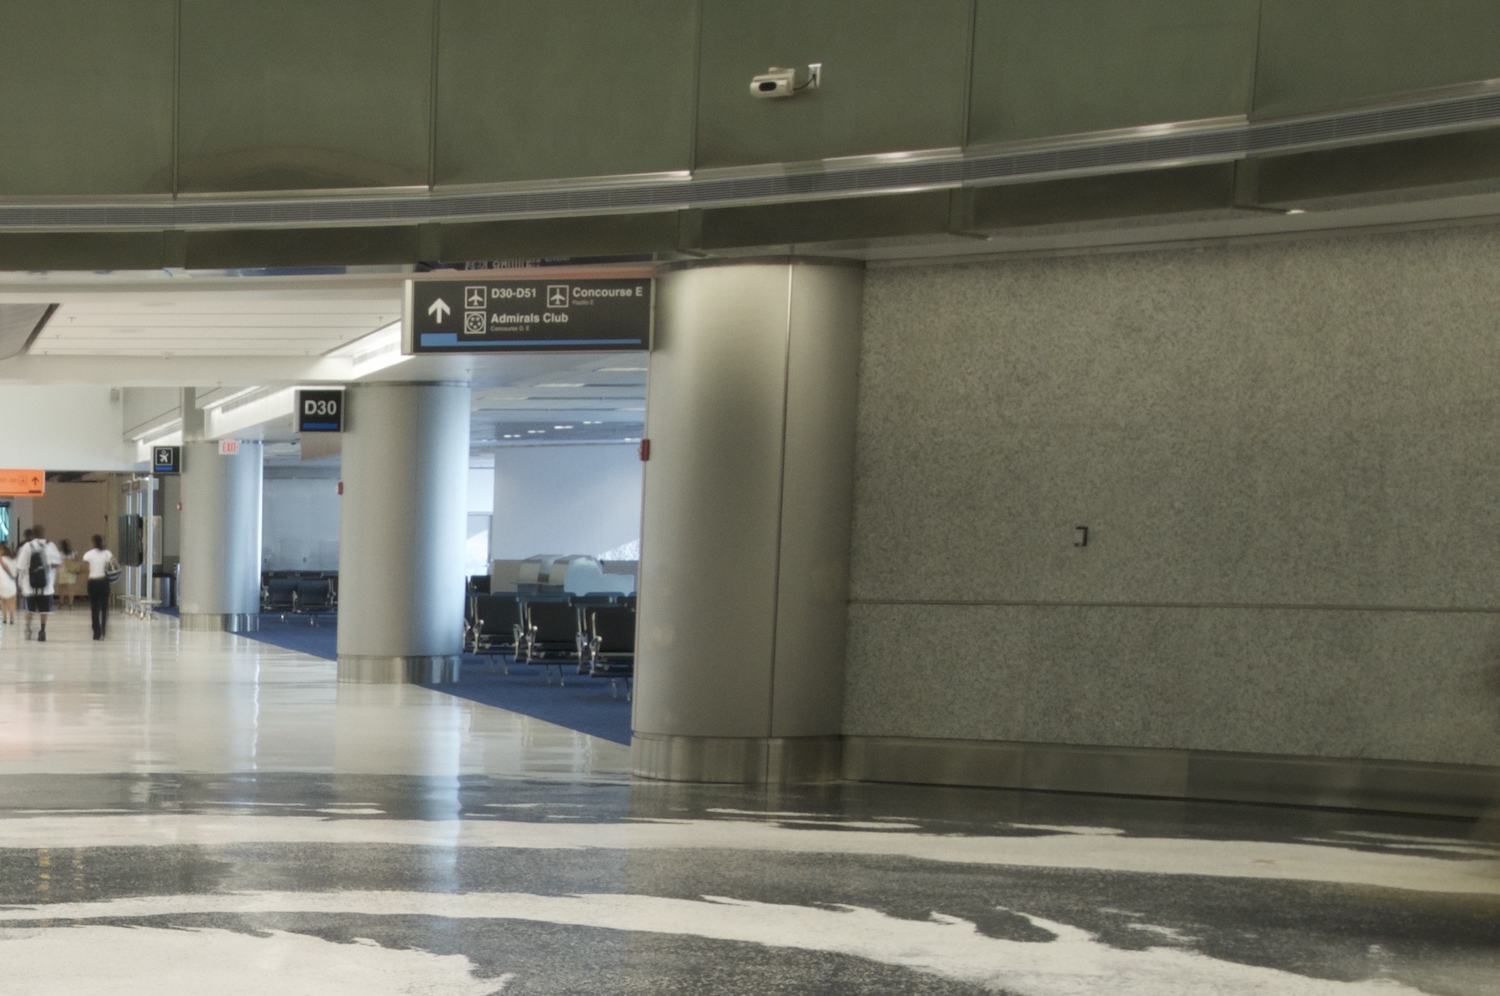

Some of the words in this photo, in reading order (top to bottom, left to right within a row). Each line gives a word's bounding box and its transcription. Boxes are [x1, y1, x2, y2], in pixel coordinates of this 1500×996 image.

[492, 287, 536, 299] D30-D51
[573, 286, 633, 298] Concourse
[635, 286, 643, 297] E
[491, 313, 540, 324] Admirals
[543, 312, 569, 323] Club
[304, 399, 337, 416] D30
[222, 442, 238, 452] EXIT
